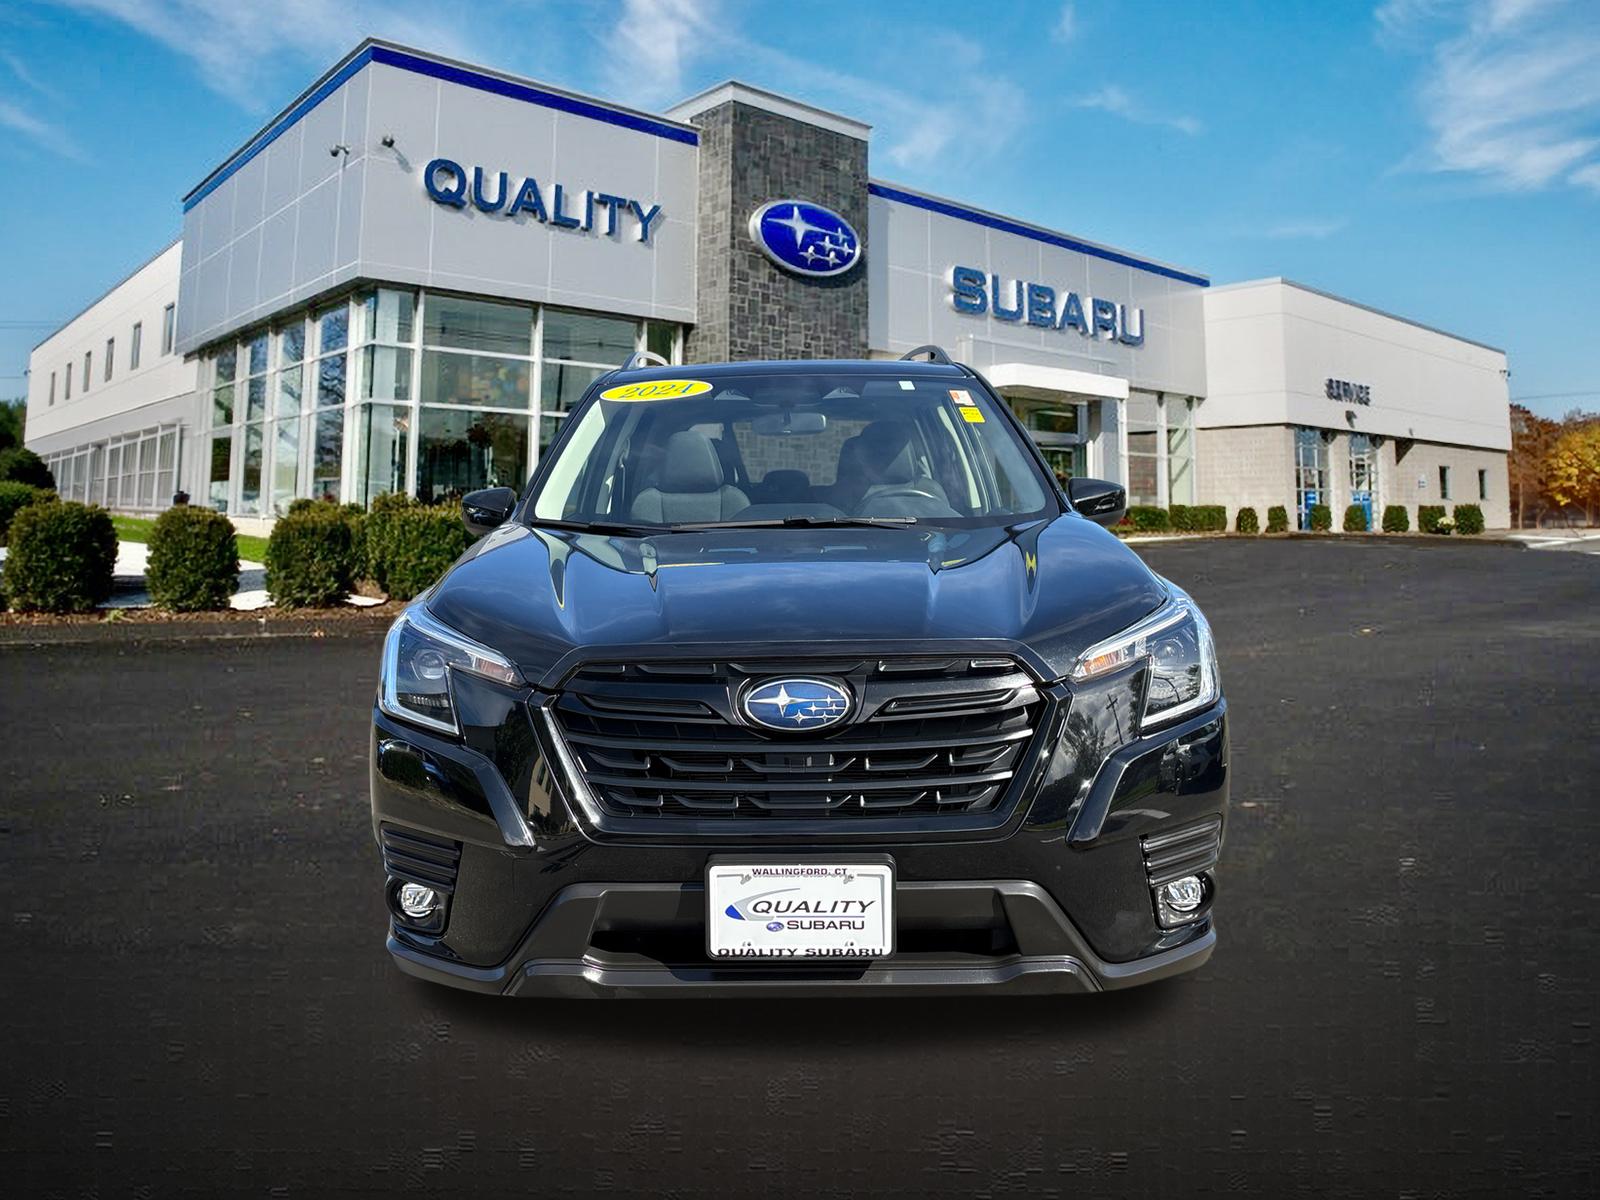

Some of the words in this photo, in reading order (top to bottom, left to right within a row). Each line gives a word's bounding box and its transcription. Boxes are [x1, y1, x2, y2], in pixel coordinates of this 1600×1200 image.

[423, 158, 662, 244] QUALITY
[948, 265, 1145, 346] SUBARU
[618, 383, 694, 398] 2024
[834, 867, 848, 876] CT
[752, 900, 875, 913] QUALITY
[786, 920, 866, 930] SUBARU
[717, 948, 798, 958] QUALITY
[805, 948, 884, 958] SUBARU
